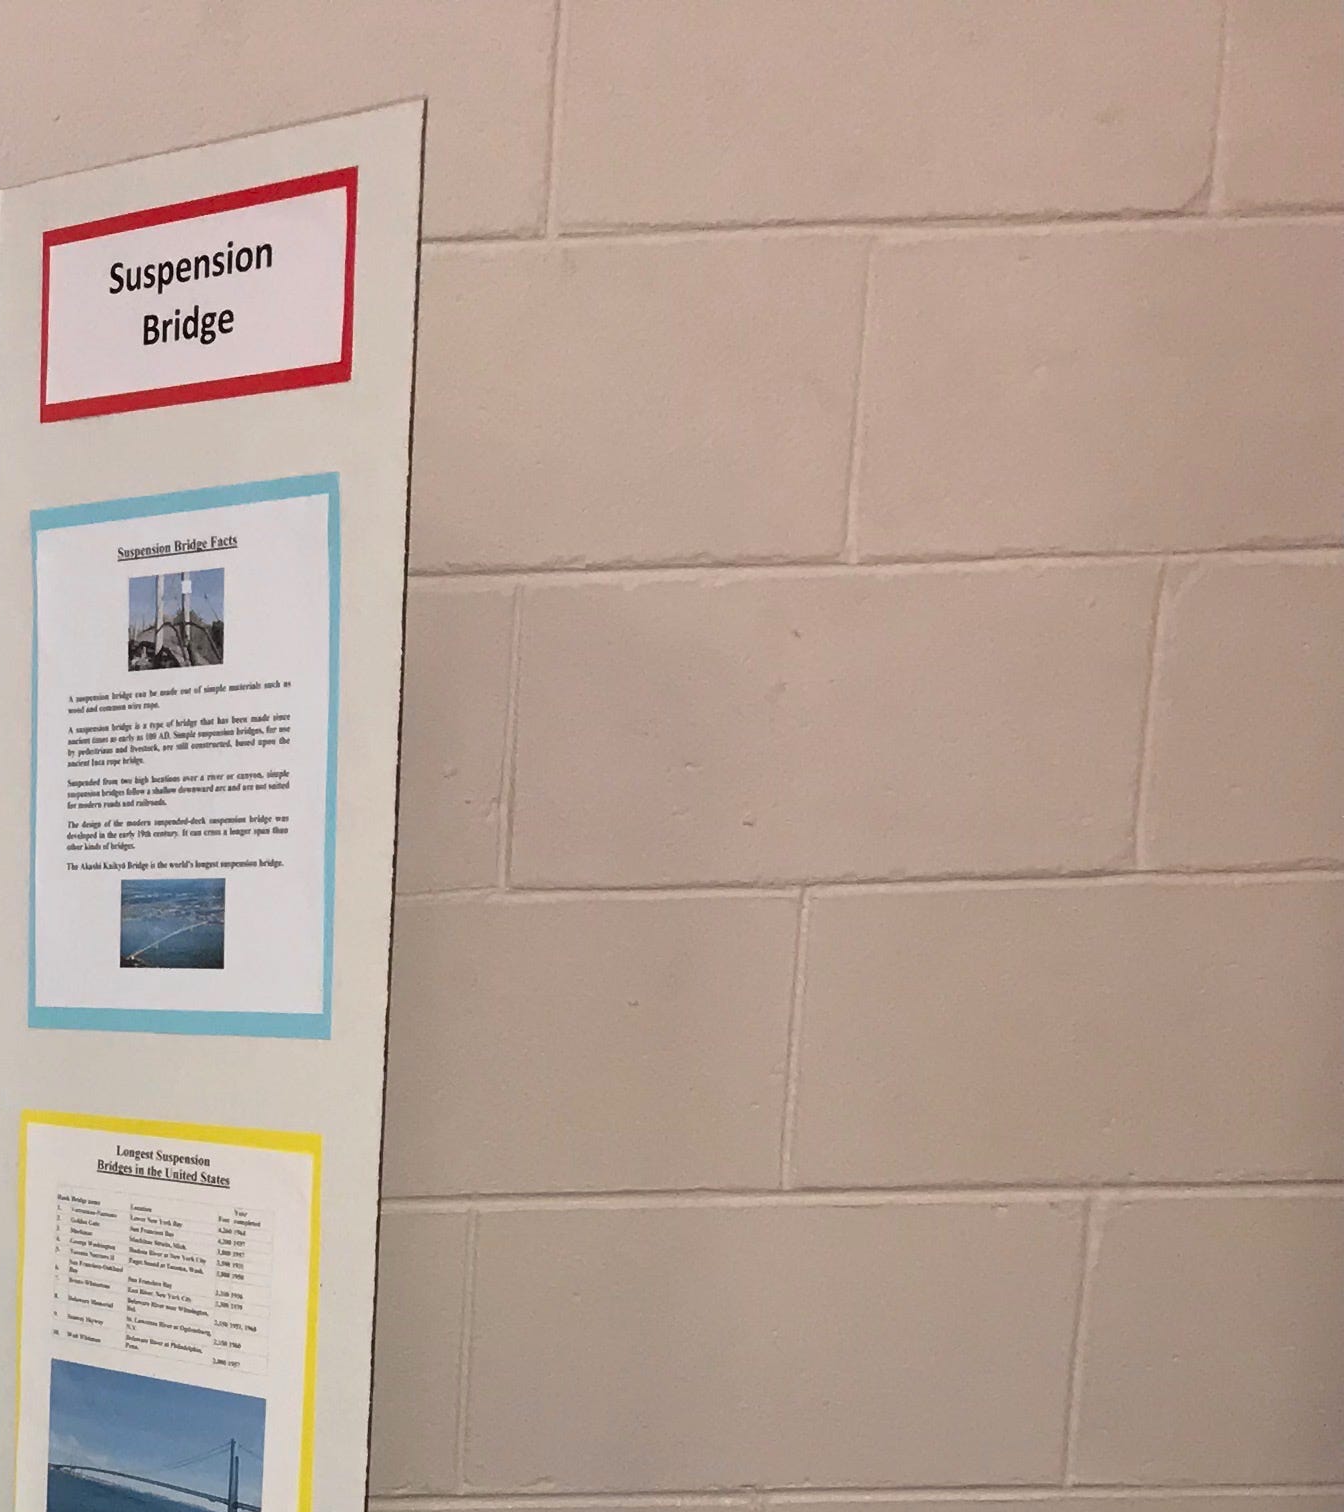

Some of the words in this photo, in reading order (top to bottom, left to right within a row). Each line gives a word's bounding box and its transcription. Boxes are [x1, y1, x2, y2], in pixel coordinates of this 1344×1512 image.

[109, 240, 272, 294] Suspension
[143, 304, 233, 345] Bridge
[117, 543, 170, 558] Suspension
[174, 539, 207, 551] Bridge
[210, 536, 238, 548] Facts
[116, 1145, 153, 1160] Longest
[156, 1150, 210, 1166] Suspension
[97, 1159, 132, 1174] Bridges
[136, 1164, 144, 1175] in
[147, 1166, 162, 1178] the
[166, 1168, 197, 1181] United
[200, 1172, 230, 1185] States
